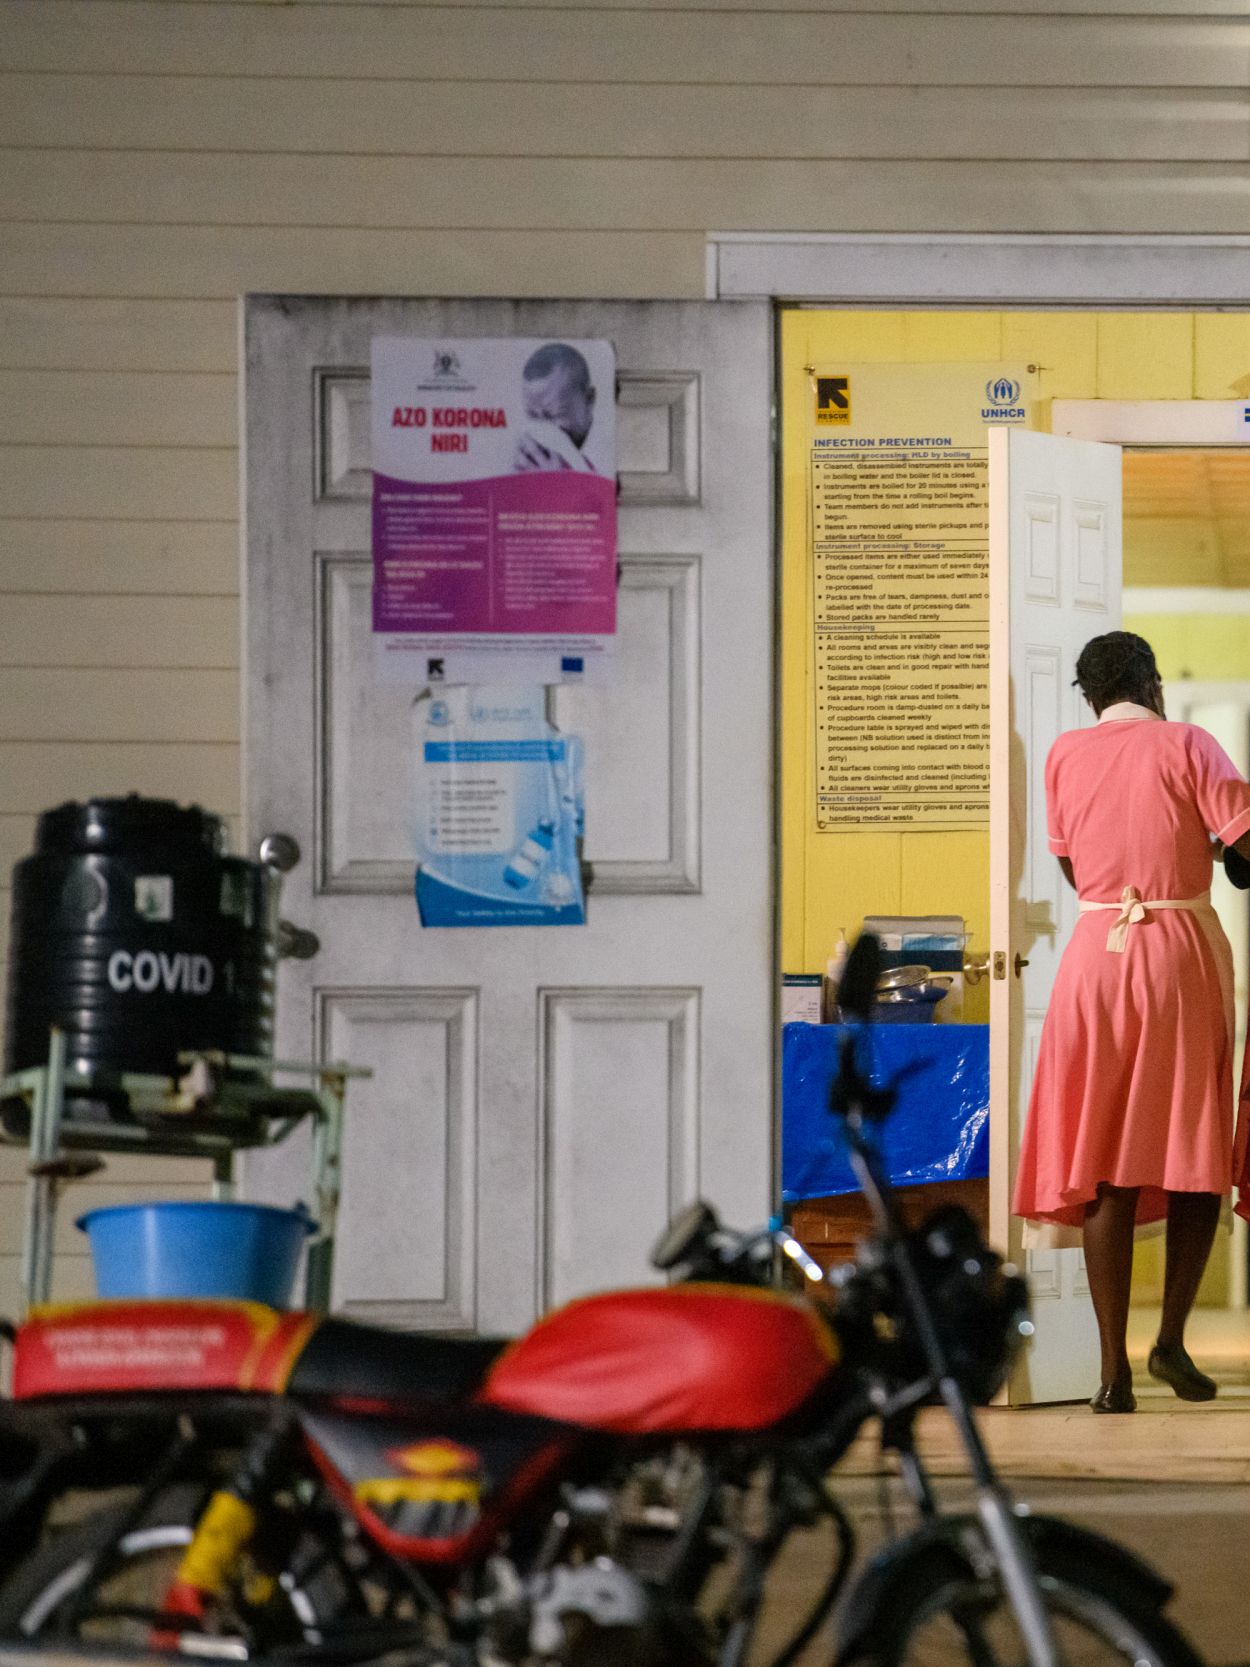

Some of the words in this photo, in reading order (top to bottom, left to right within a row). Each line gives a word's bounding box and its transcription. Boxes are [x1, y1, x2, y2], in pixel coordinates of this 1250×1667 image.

[392, 407, 426, 428] AZO
[432, 407, 507, 428] KORONA
[982, 408, 1025, 418] UNHCR
[431, 433, 468, 453] NIRI
[108, 950, 213, 994] COVID
